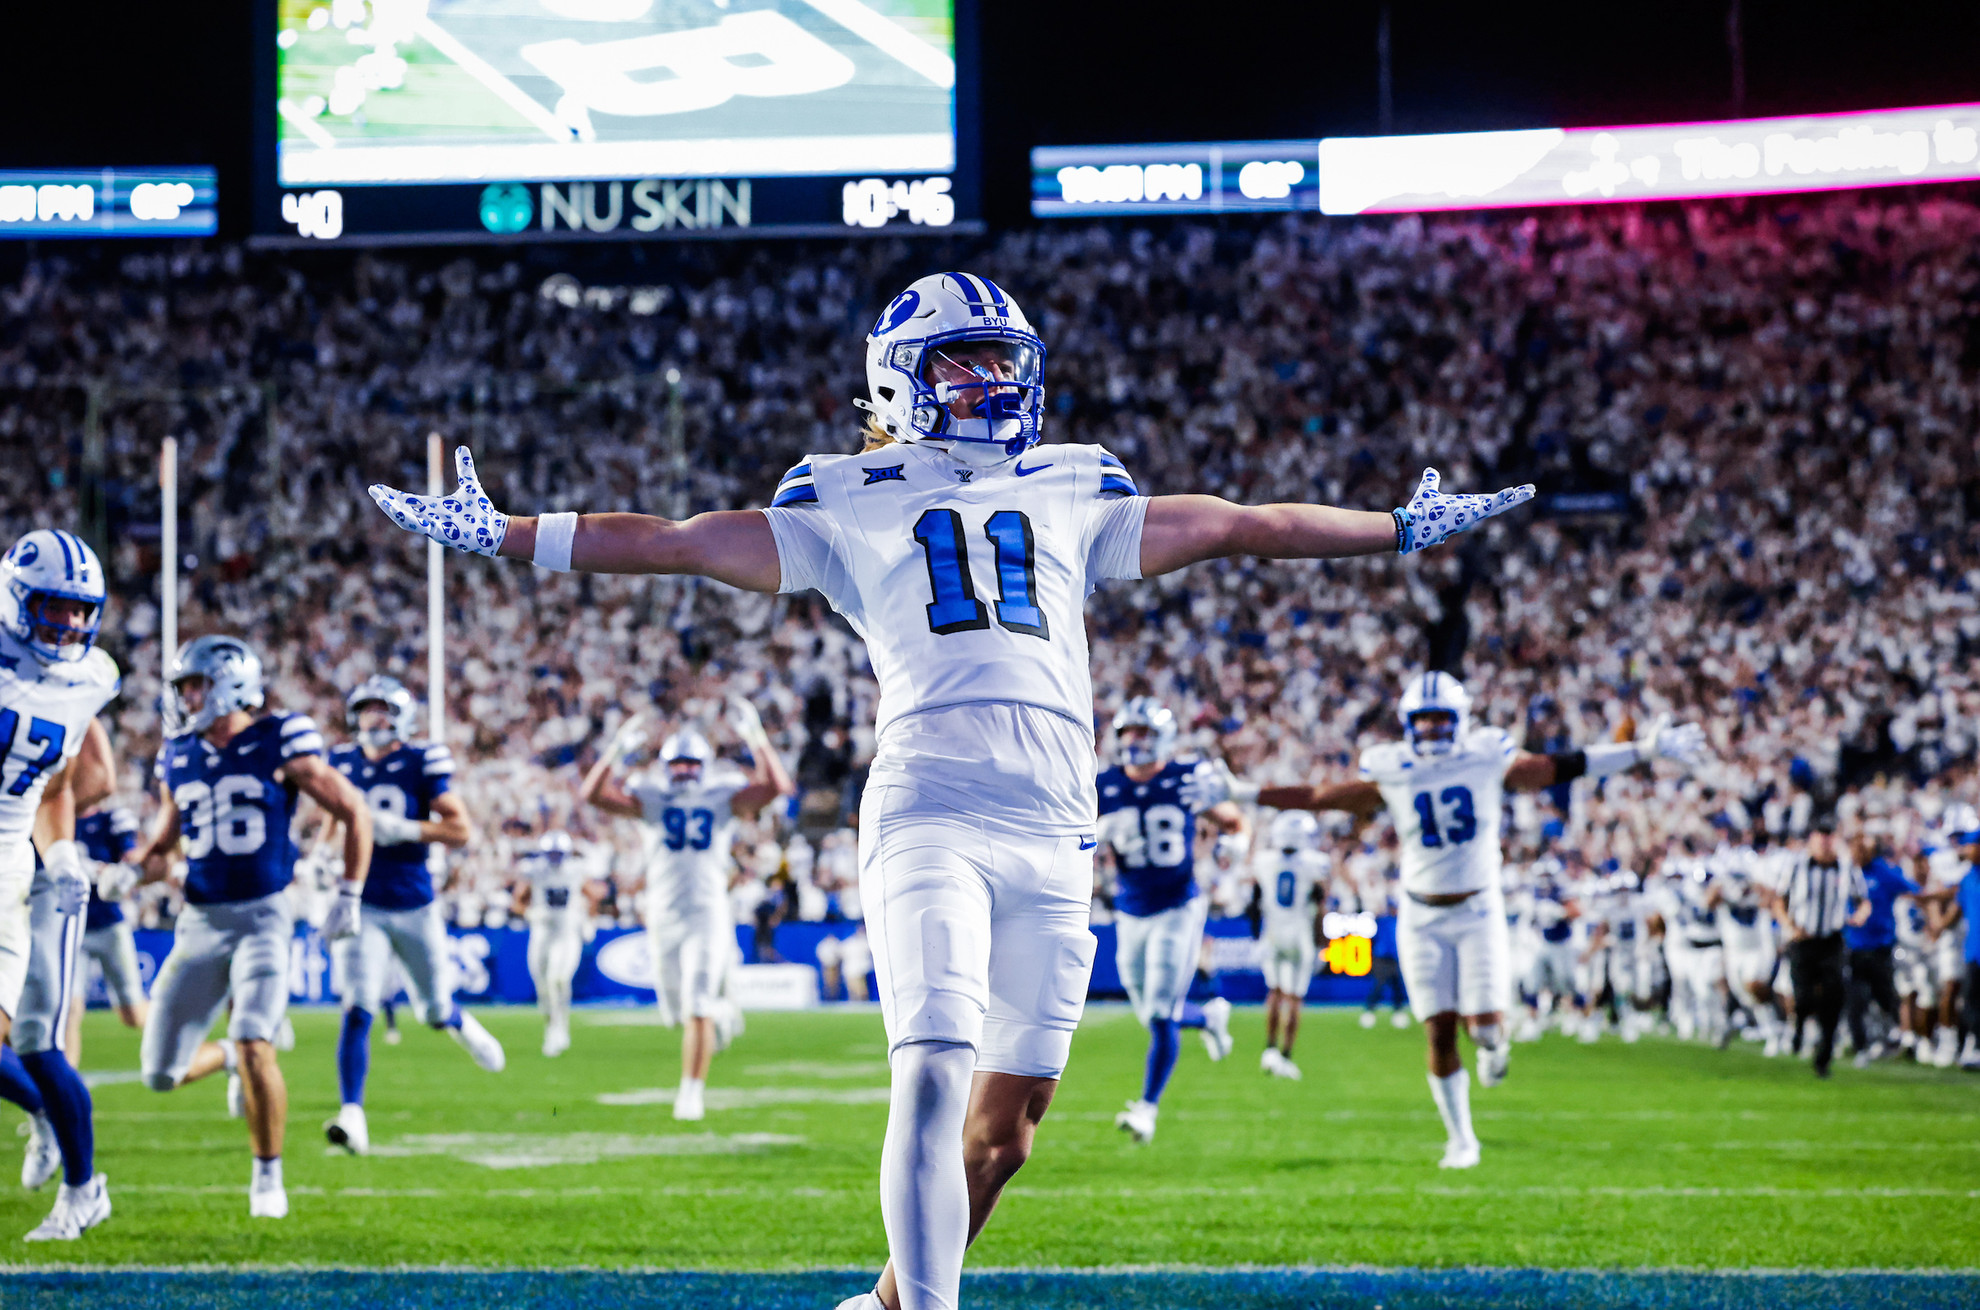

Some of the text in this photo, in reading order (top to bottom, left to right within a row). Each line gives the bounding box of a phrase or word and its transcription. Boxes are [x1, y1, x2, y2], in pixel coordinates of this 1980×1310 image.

[281, 190, 343, 239] 40
[540, 178, 751, 232] NU SKIN
[982, 316, 1008, 327] BYU
[862, 463, 907, 486] XII
[954, 469, 973, 482] Y
[912, 508, 1051, 642] 11
[174, 773, 267, 860] 36
[662, 806, 714, 850] 93
[1097, 803, 1187, 868] 48
[1414, 785, 1477, 847] 13
[1277, 871, 1295, 907] 0
